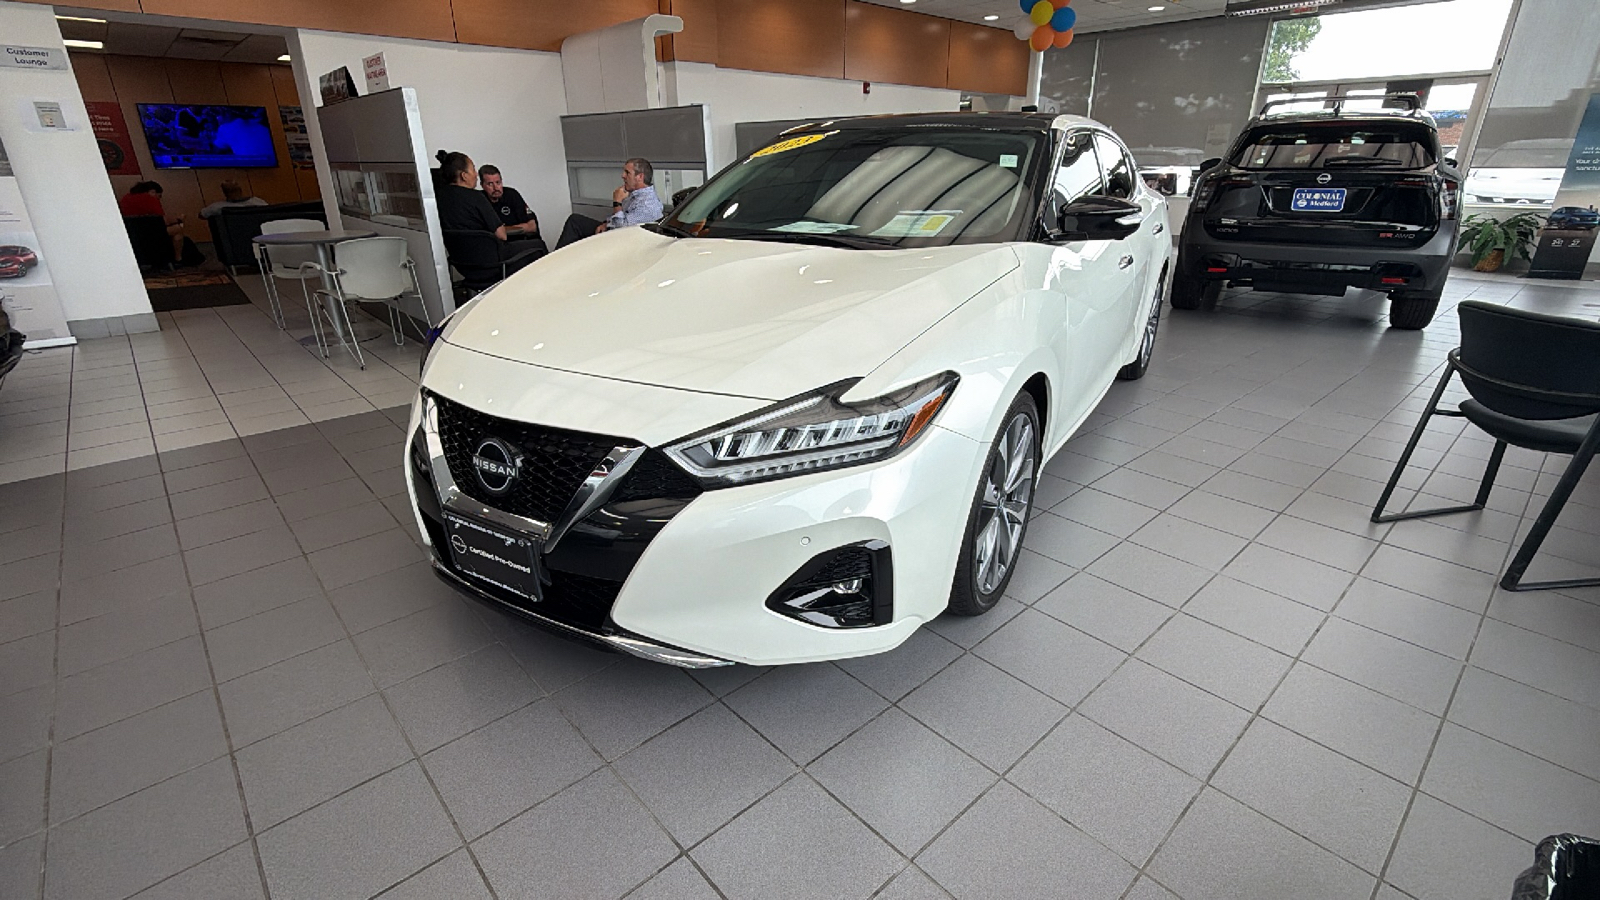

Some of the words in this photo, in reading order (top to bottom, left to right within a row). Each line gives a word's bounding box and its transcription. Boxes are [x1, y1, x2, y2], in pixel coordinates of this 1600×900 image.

[6, 48, 49, 57] Customer
[14, 57, 48, 66] Lounge
[1296, 192, 1342, 200] COLONIAL
[472, 456, 516, 476] NISSAN
[469, 546, 495, 561] Certified
[494, 555, 531, 574] Pre-Owned
